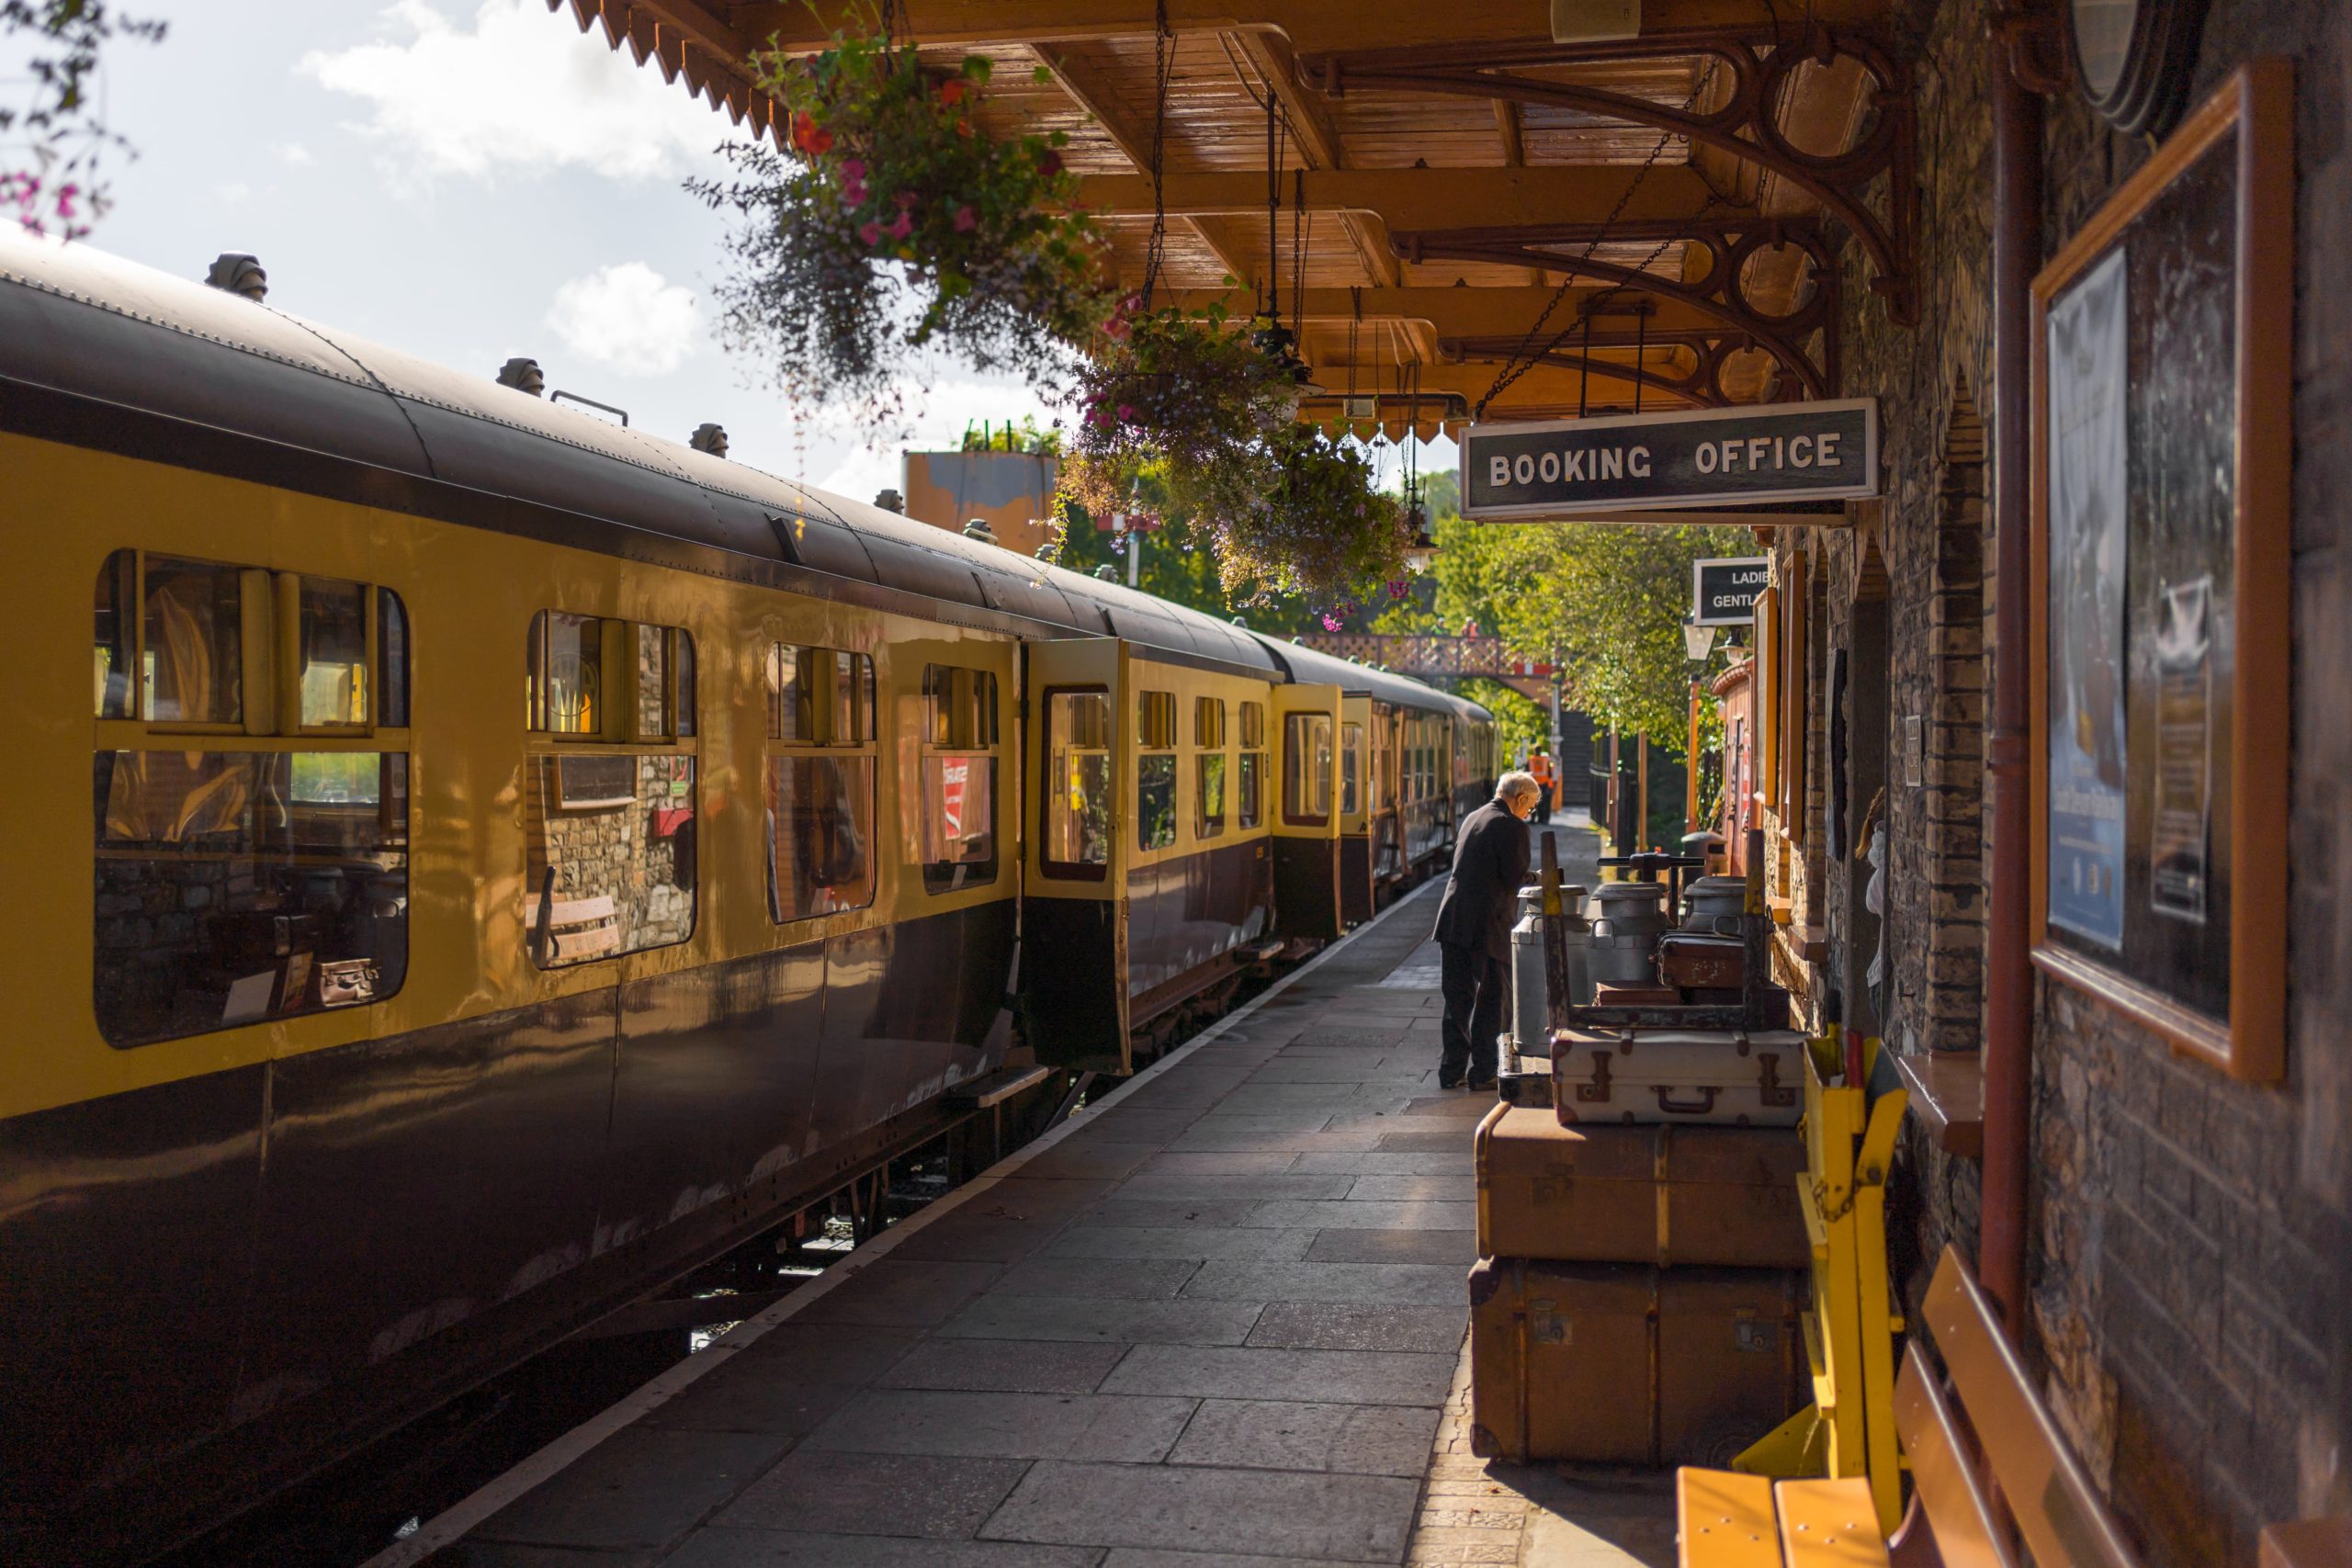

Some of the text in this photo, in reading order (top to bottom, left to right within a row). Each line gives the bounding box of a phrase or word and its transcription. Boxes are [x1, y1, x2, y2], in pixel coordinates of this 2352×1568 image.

[1489, 432, 1842, 488] BOOKING OFFICE
[1732, 570, 1769, 585] LADIE
[1713, 593, 1758, 608] GENTL
